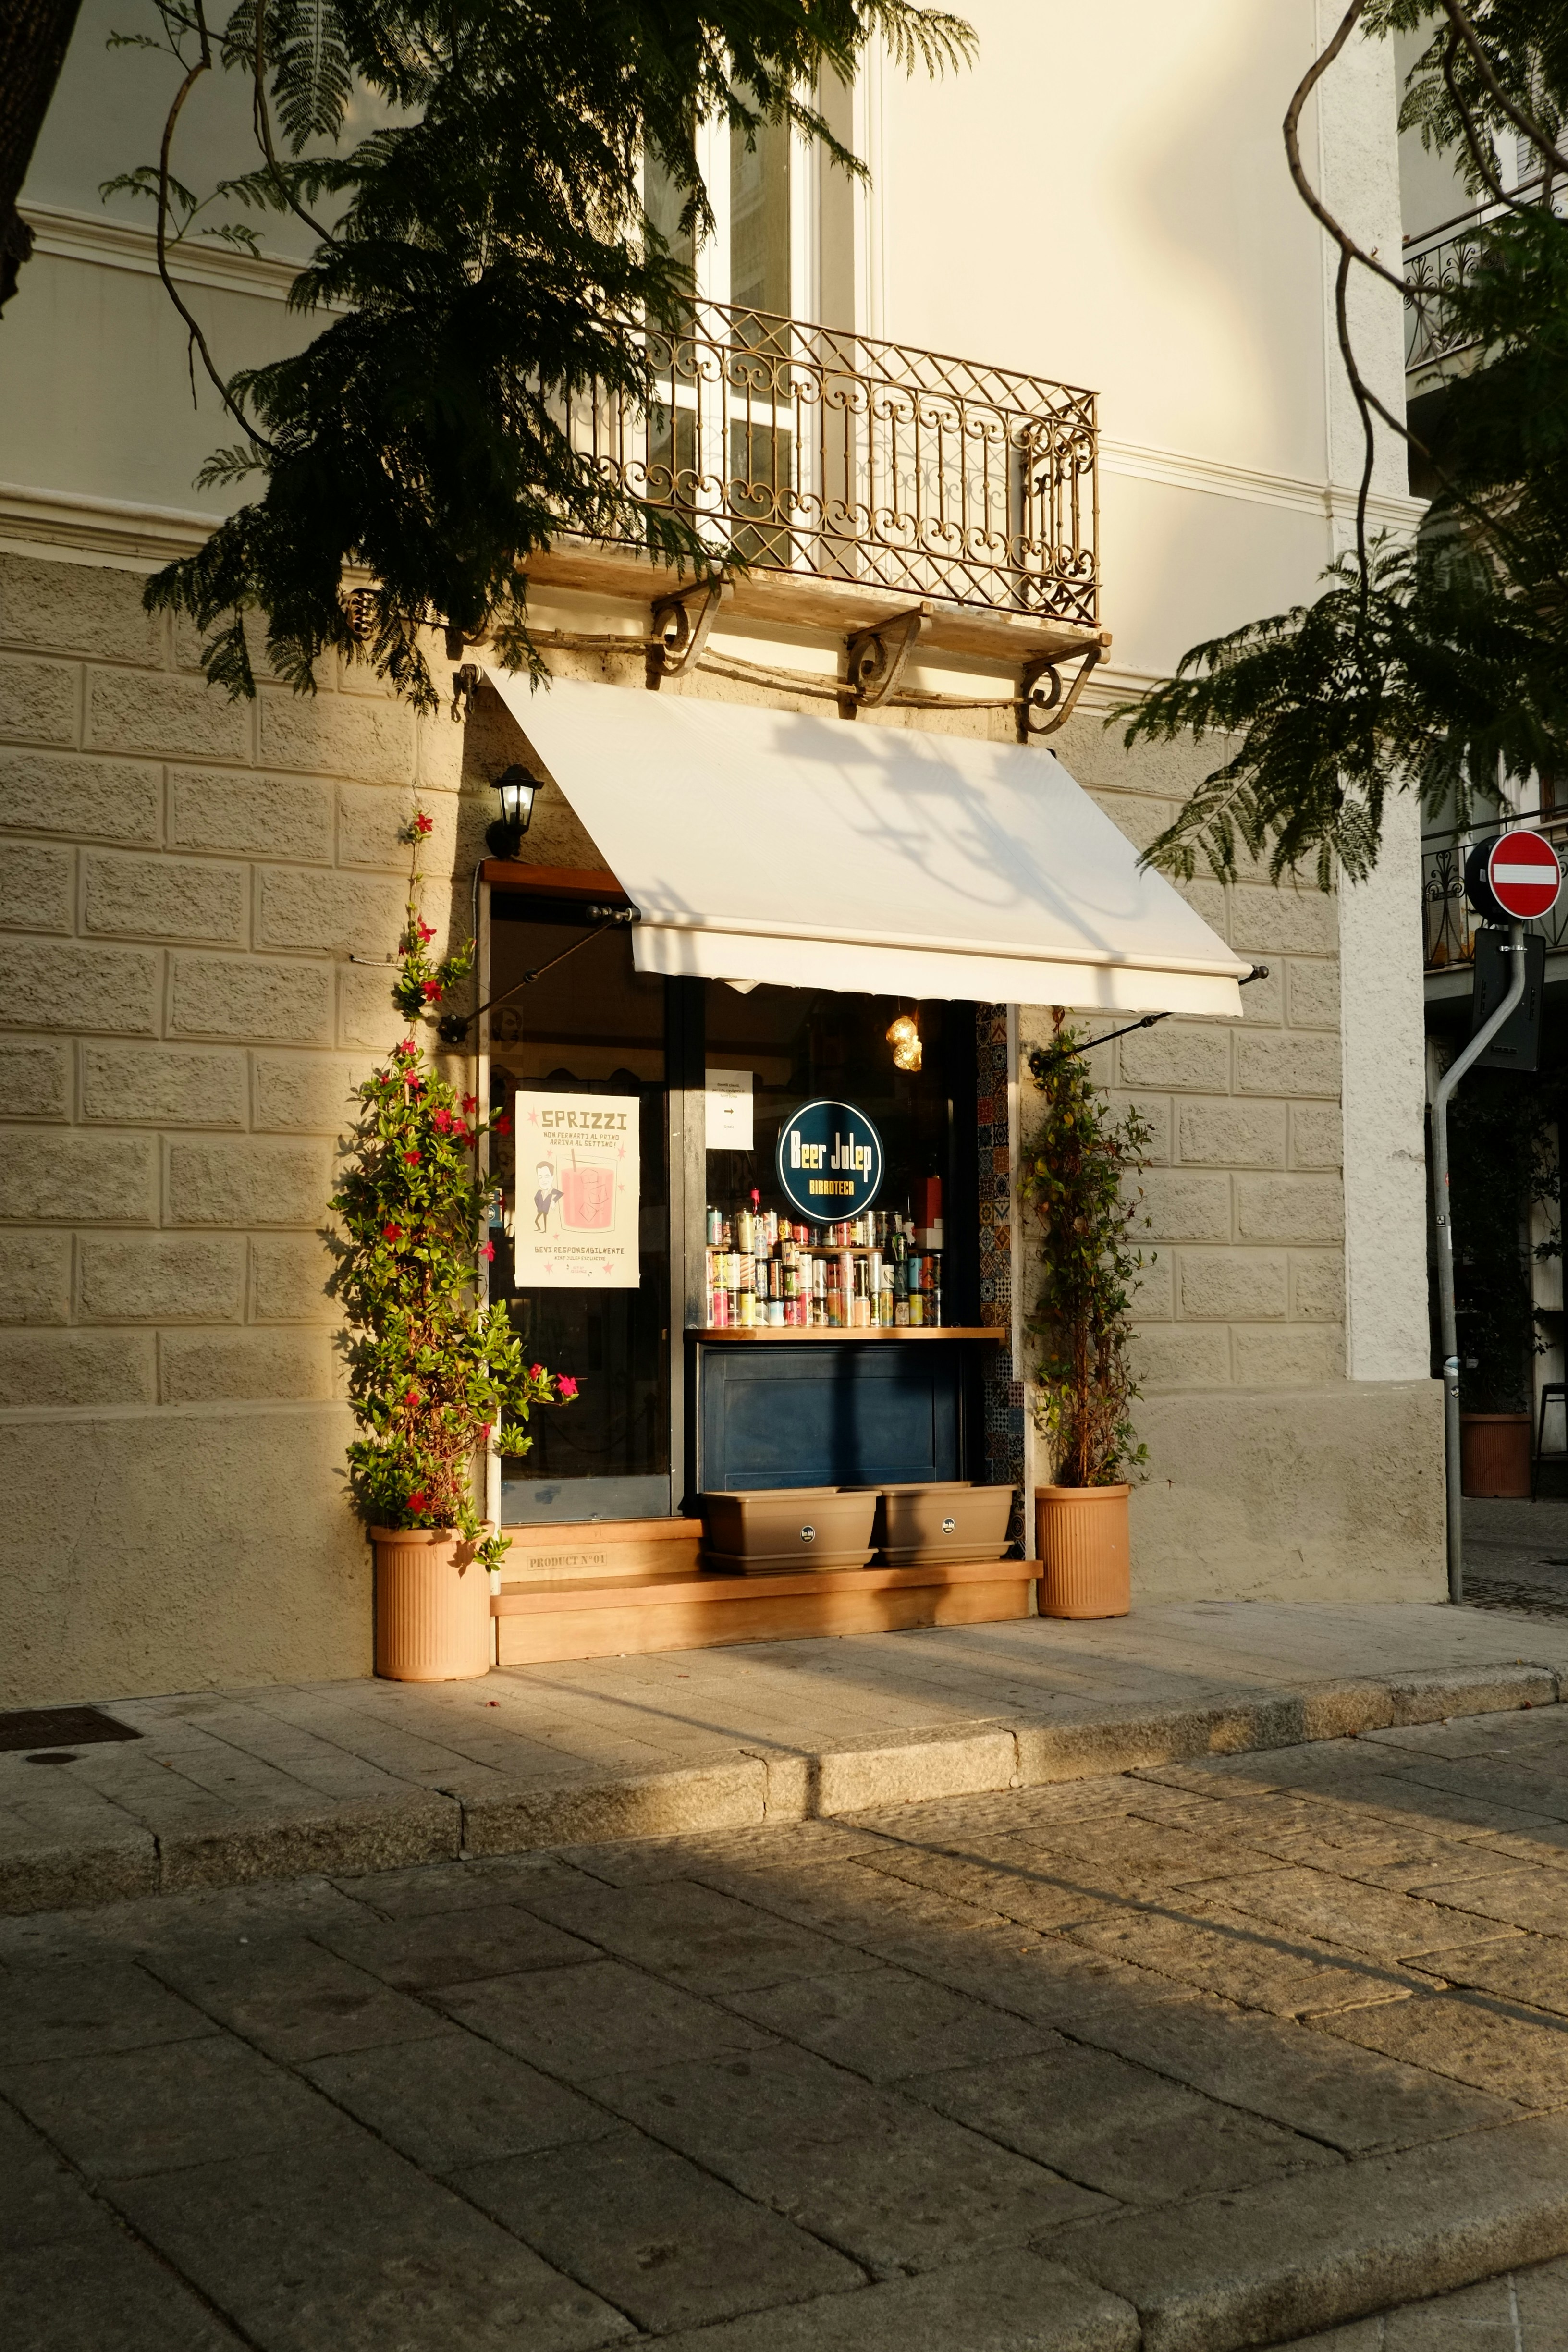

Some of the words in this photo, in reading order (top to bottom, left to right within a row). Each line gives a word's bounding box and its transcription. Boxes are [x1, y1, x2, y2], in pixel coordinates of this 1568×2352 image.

[542, 1110, 627, 1130] SPRIZZI
[791, 1130, 827, 1169] Beer
[831, 1132, 872, 1183] Julep
[809, 1180, 854, 1195] BIRROTECA
[530, 1556, 578, 1568] PRODUCT
